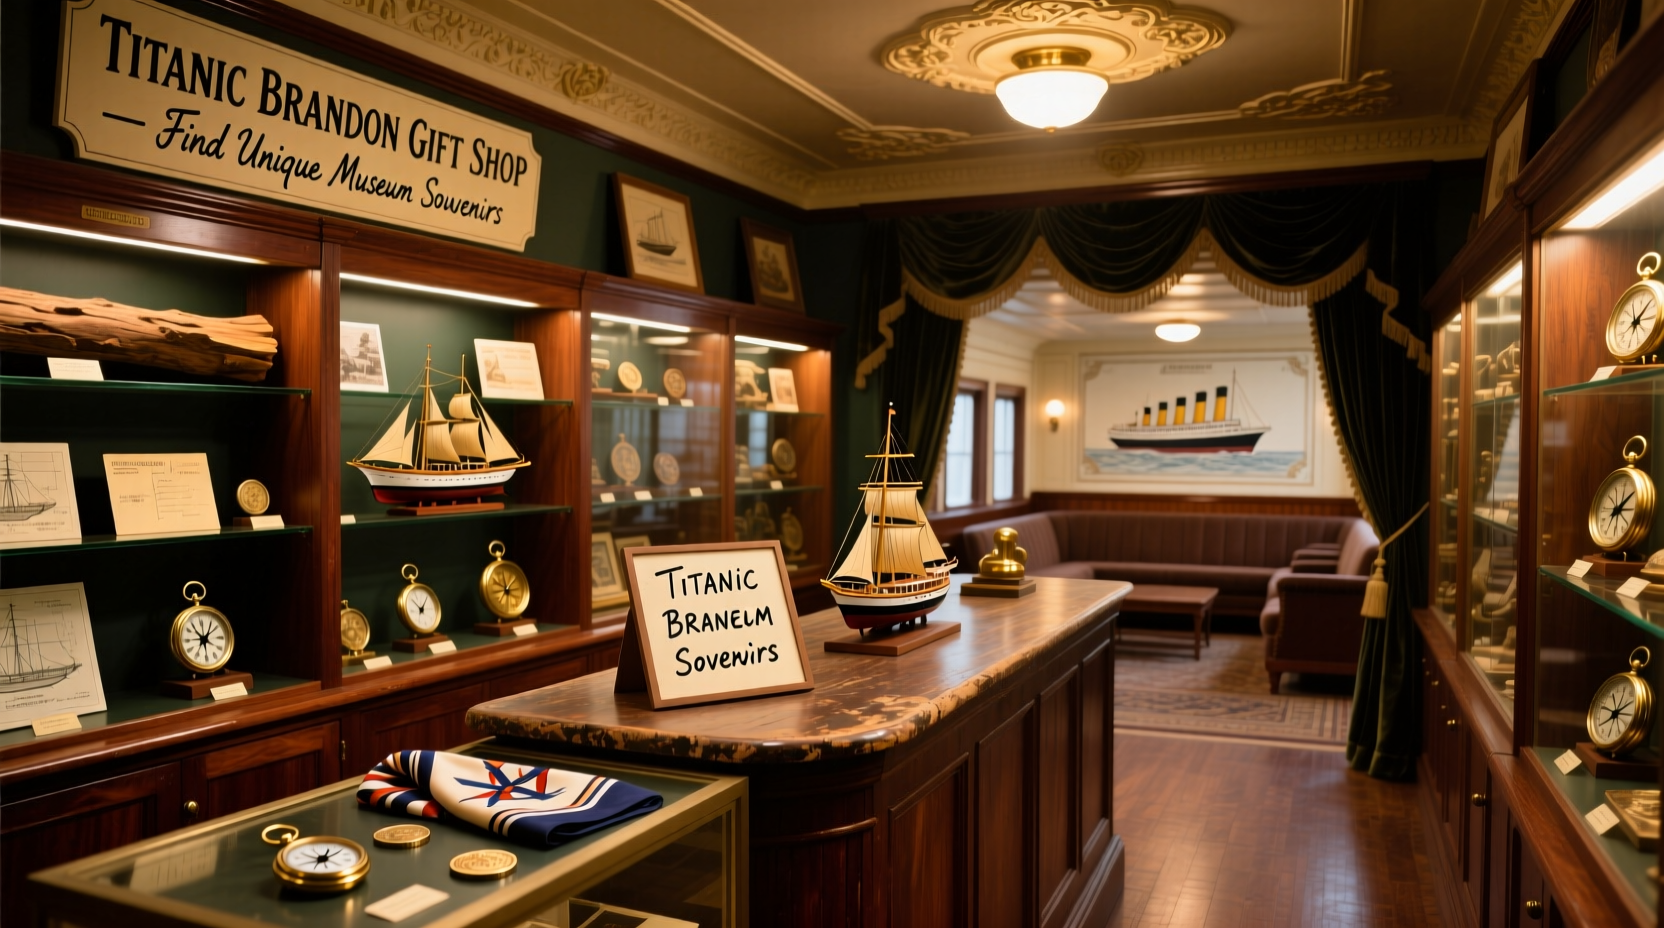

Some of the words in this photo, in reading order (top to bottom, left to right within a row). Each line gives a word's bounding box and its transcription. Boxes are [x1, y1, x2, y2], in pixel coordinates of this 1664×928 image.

[100, 13, 247, 107] TITANIC
[257, 67, 400, 152] BRANDON
[408, 118, 464, 169] GIFT
[469, 138, 528, 187] SHOP
[155, 107, 231, 160] Find
[237, 128, 323, 190] Unique
[327, 152, 414, 203] Museum
